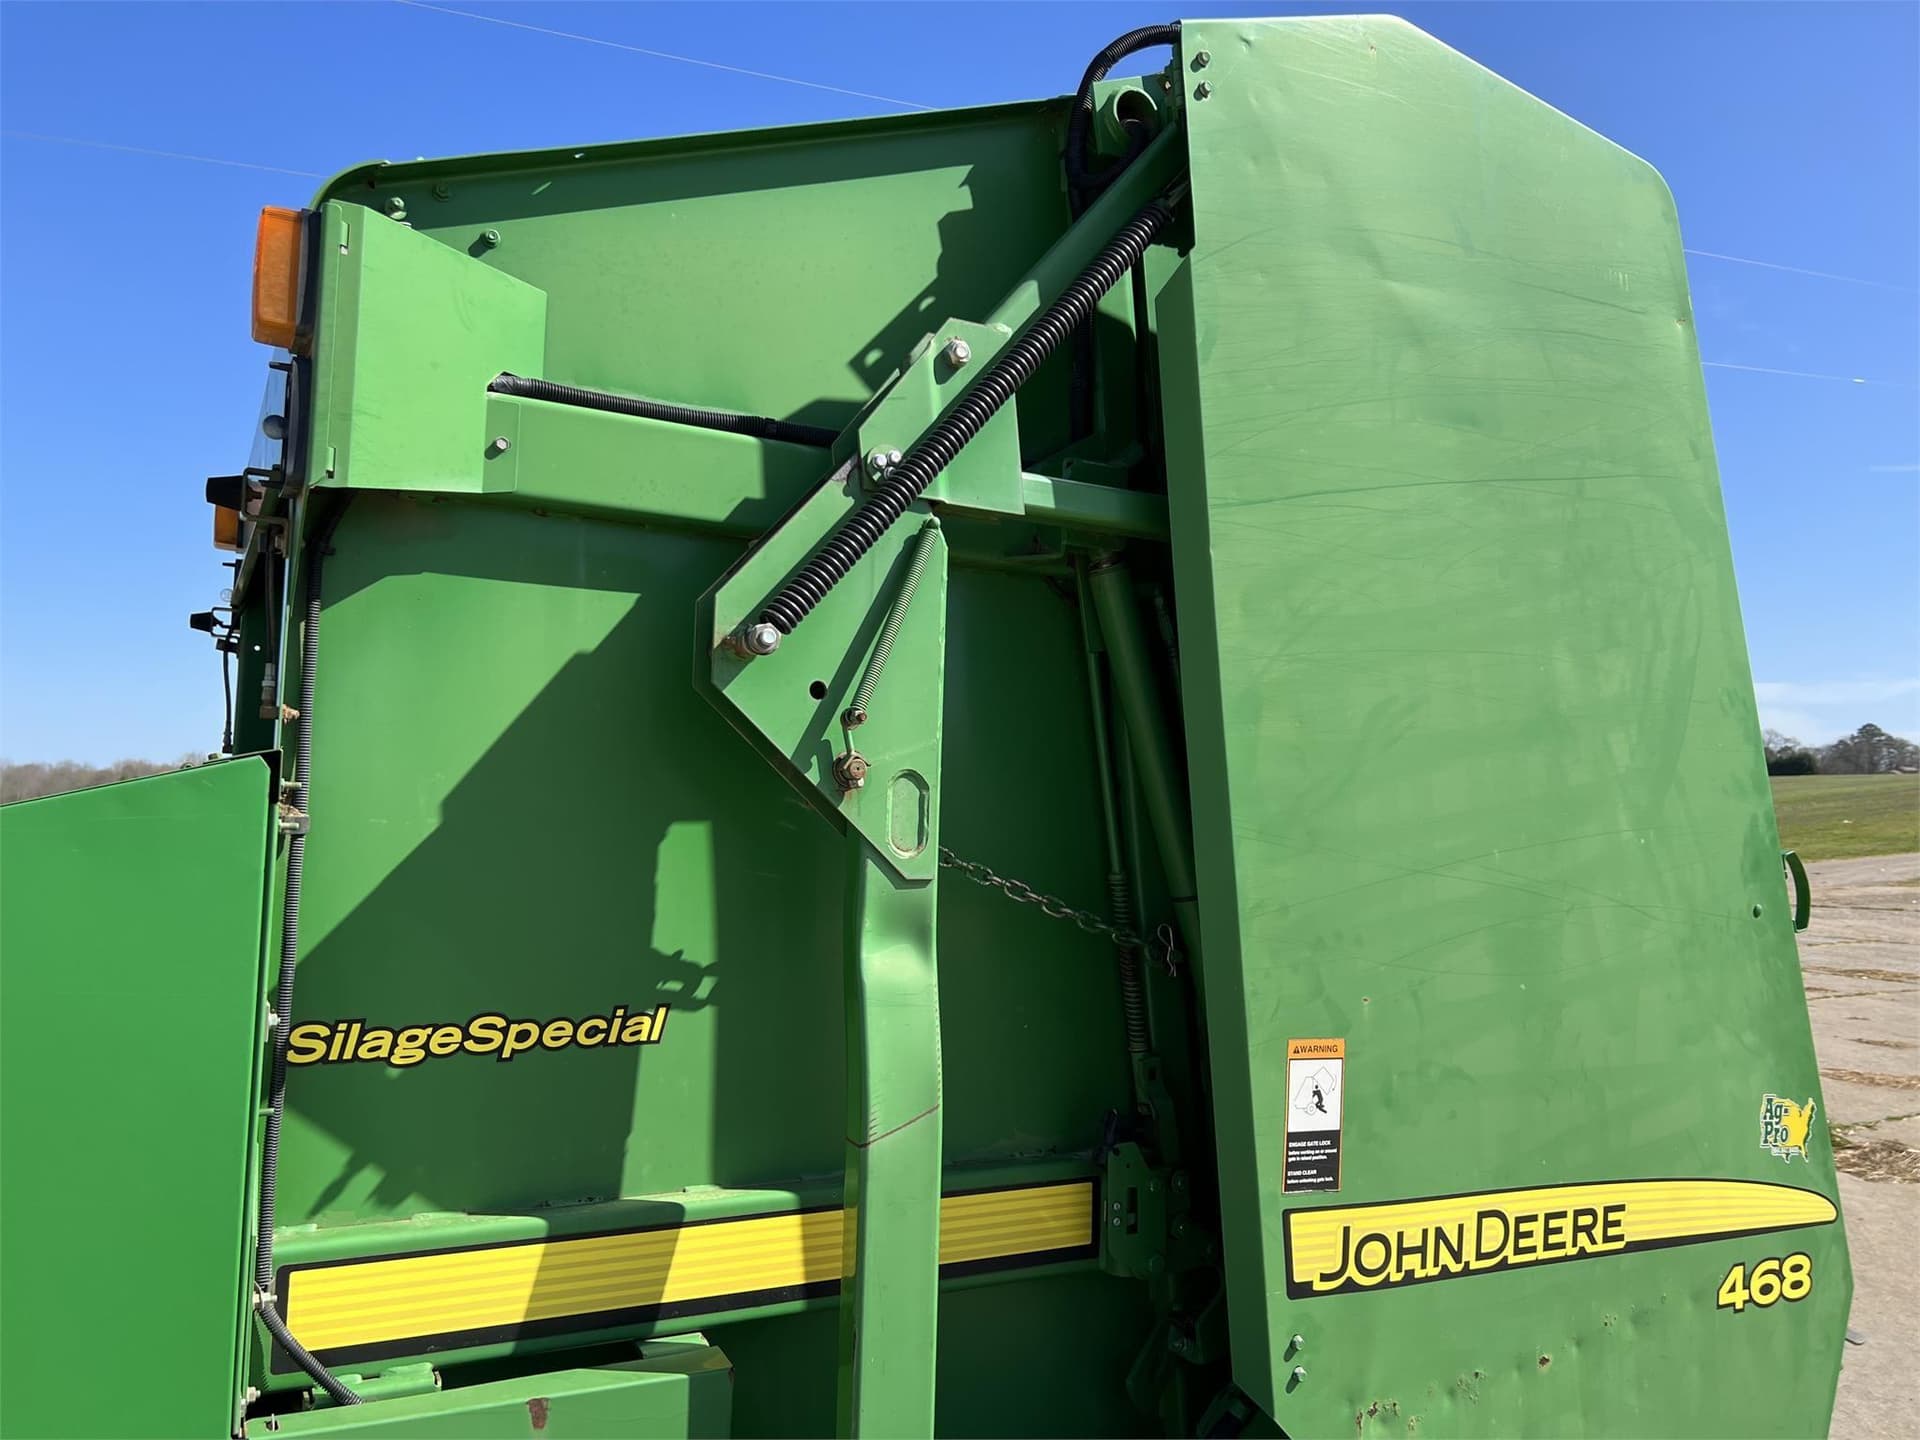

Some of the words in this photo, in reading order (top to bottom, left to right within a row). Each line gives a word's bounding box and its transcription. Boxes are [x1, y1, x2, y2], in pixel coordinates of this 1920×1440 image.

[286, 1006, 668, 1065] SilageSpecial
[1300, 1044, 1338, 1054] WARNING
[1763, 1121, 1789, 1144] Pro
[1318, 1223, 1464, 1282] JOHN
[1476, 1203, 1626, 1262] DEERE
[1717, 1254, 1813, 1311] 468
